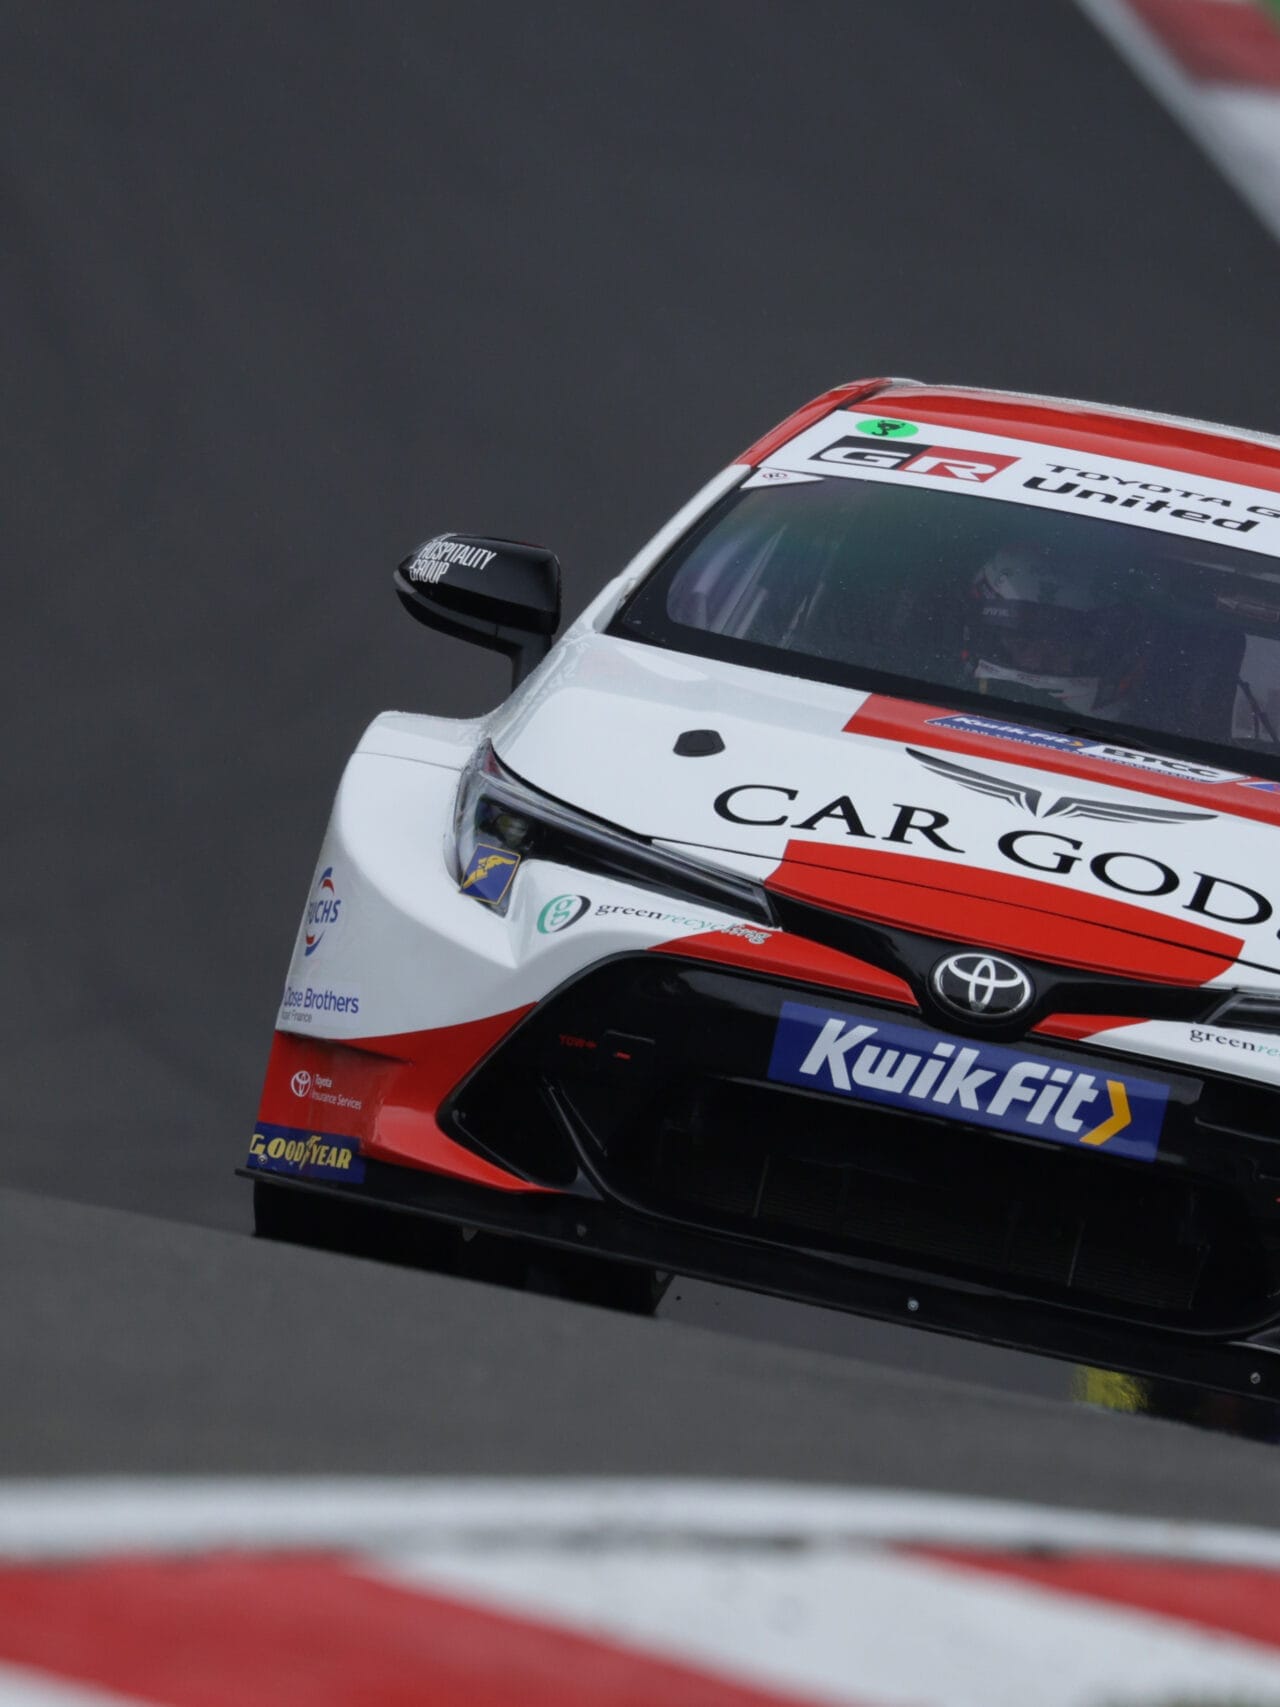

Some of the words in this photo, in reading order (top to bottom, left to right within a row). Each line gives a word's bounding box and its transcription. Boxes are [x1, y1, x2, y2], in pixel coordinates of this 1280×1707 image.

[820, 446, 997, 481] GR
[1046, 463, 1232, 507] TOYOTA
[1022, 476, 1260, 533] United
[417, 540, 498, 570] HOSPITALITY
[409, 559, 450, 584] GROUP
[711, 783, 967, 855] CAR
[304, 987, 360, 1014] Brothers
[314, 1073, 333, 1090] Toyota
[337, 1093, 362, 1111] Services
[250, 1133, 353, 1171] GOODYEAR
